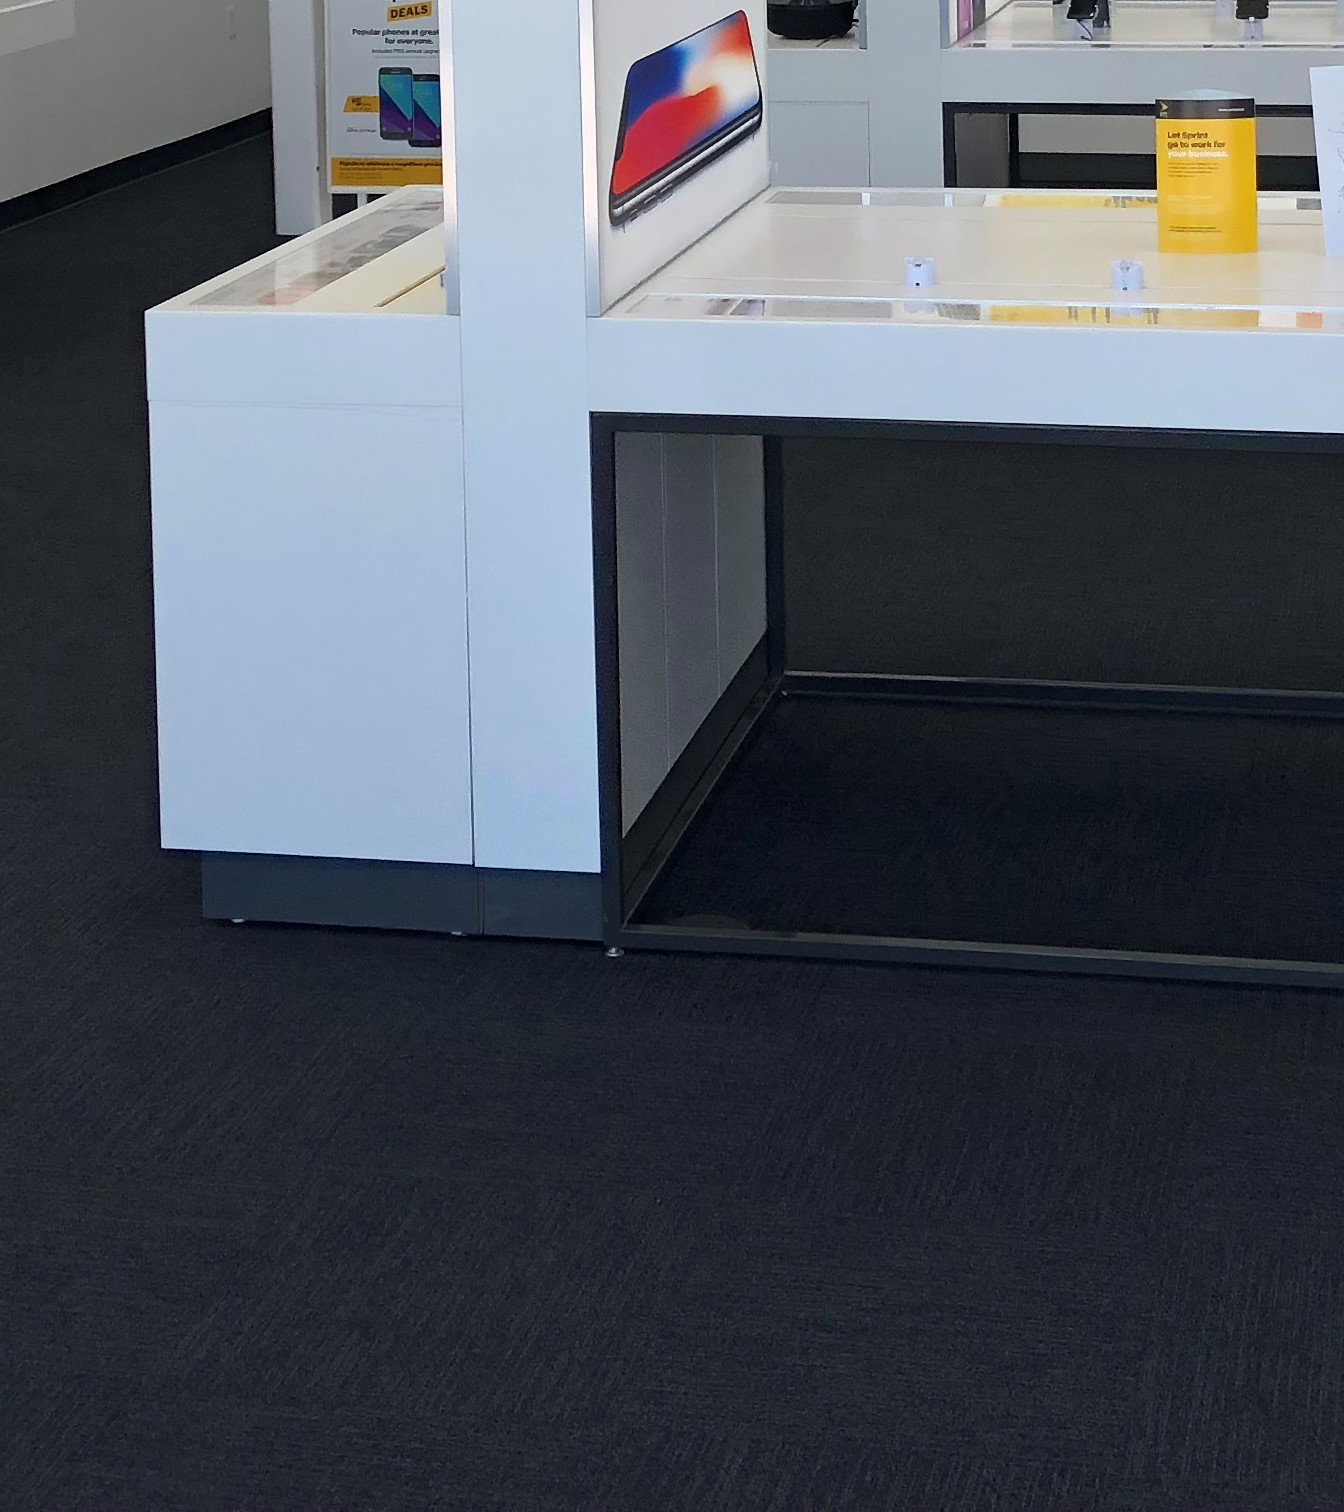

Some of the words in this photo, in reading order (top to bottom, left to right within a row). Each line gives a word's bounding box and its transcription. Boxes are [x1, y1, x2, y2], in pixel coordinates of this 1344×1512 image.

[390, 4, 429, 19] DEALS
[1167, 131, 1180, 139] Let
[1182, 131, 1208, 140] Sprint
[1213, 140, 1226, 148] for
[1167, 151, 1186, 159] your
